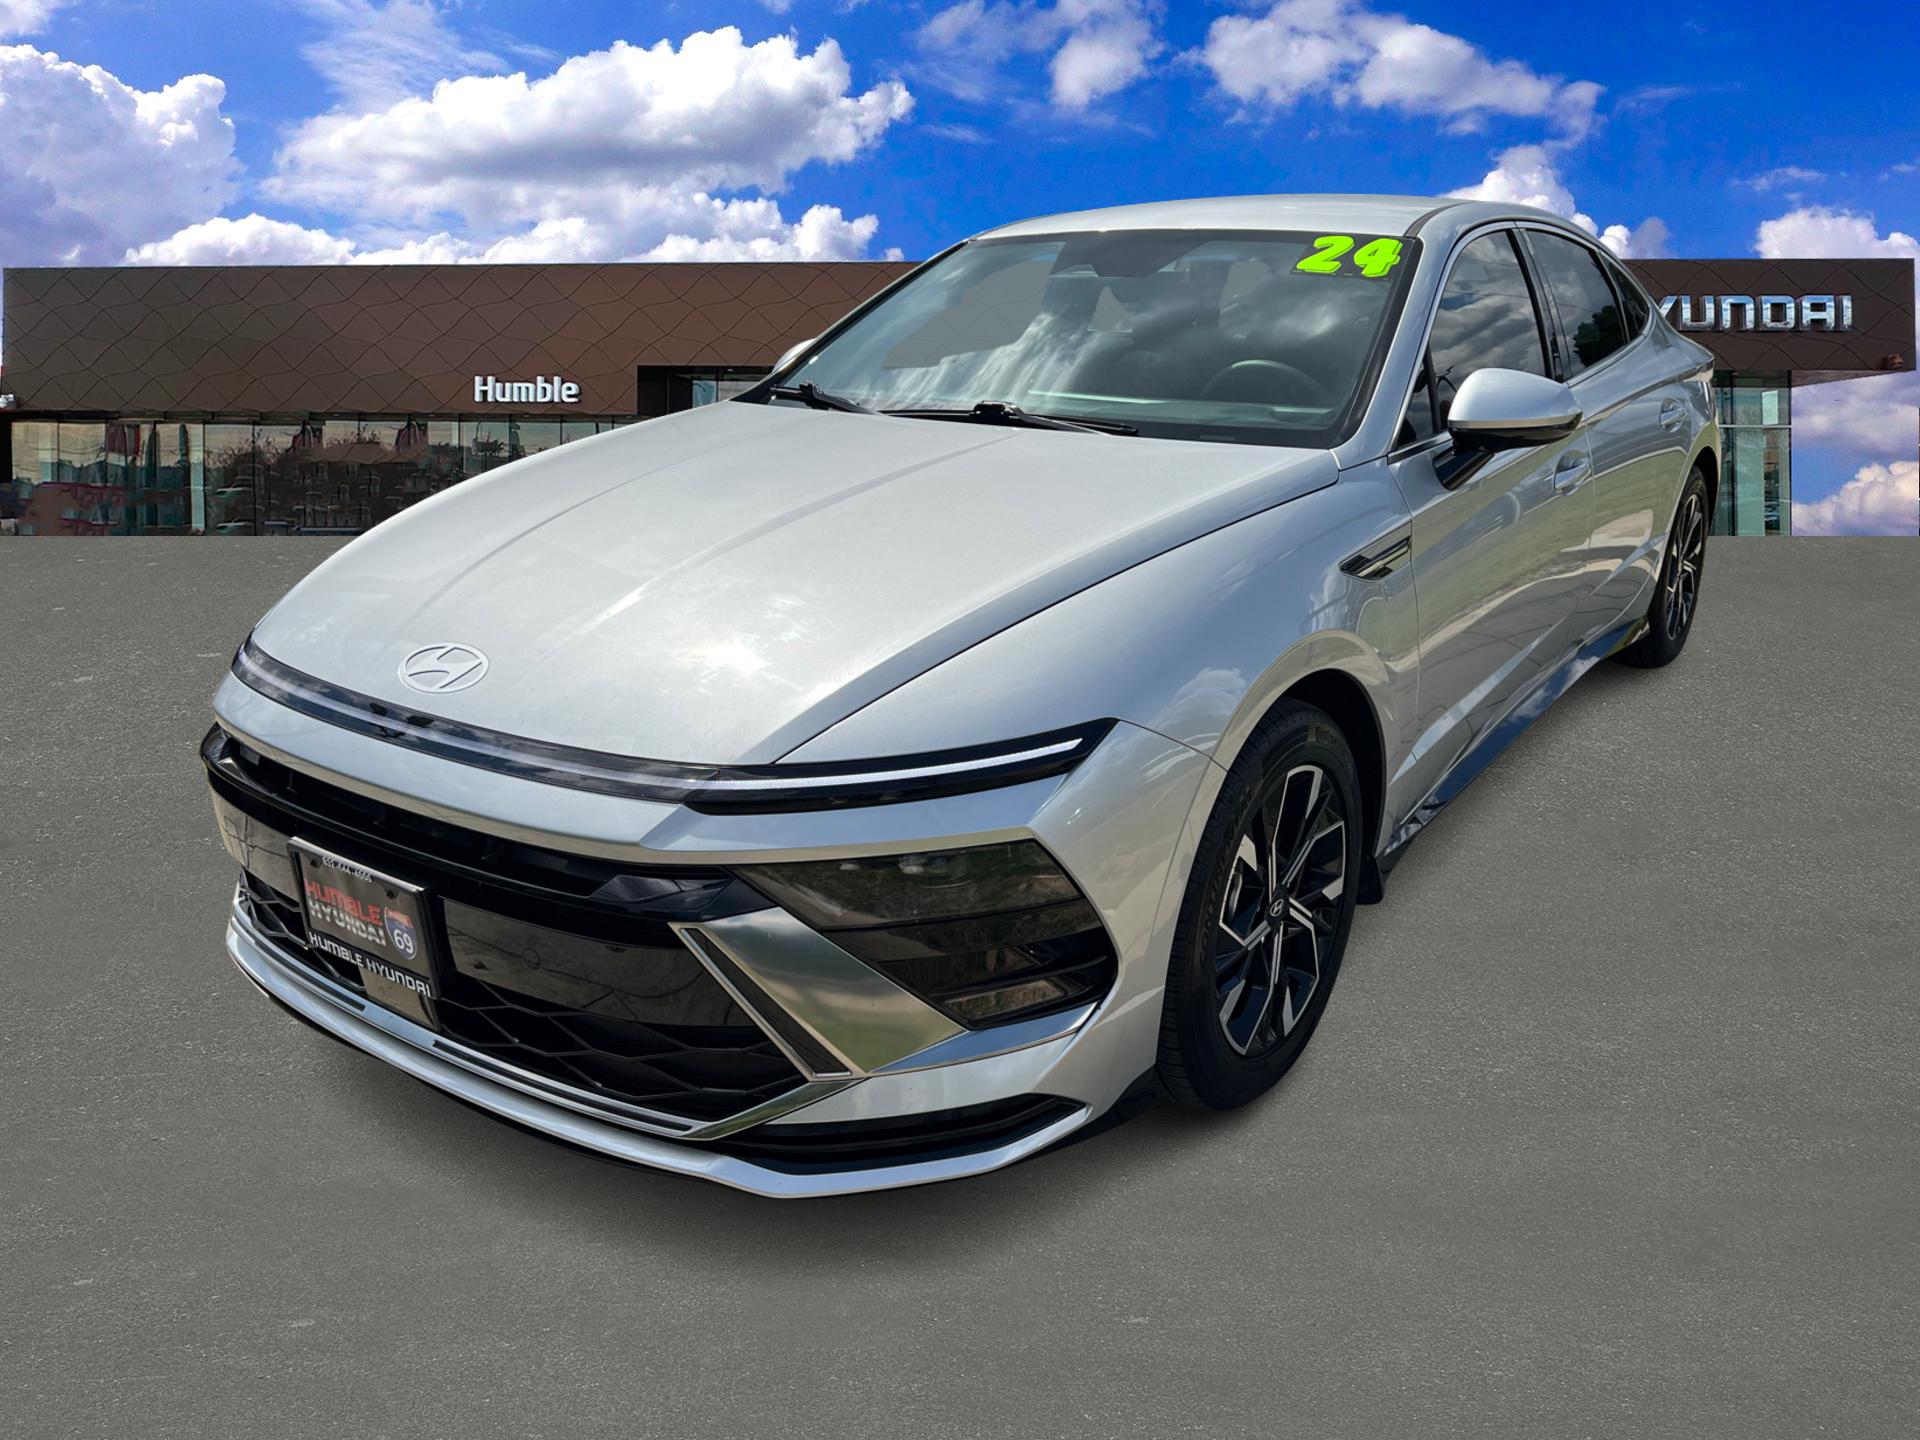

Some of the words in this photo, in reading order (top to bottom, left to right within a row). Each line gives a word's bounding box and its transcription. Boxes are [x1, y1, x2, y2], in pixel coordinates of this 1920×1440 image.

[1296, 235, 1404, 278] 24
[474, 375, 580, 403] Humble
[304, 879, 383, 926] HUMBLE
[308, 897, 387, 947] HYUNDAI
[393, 928, 414, 954] 69
[309, 931, 364, 968] HUMBLE
[366, 957, 431, 998] HYUNDAI
